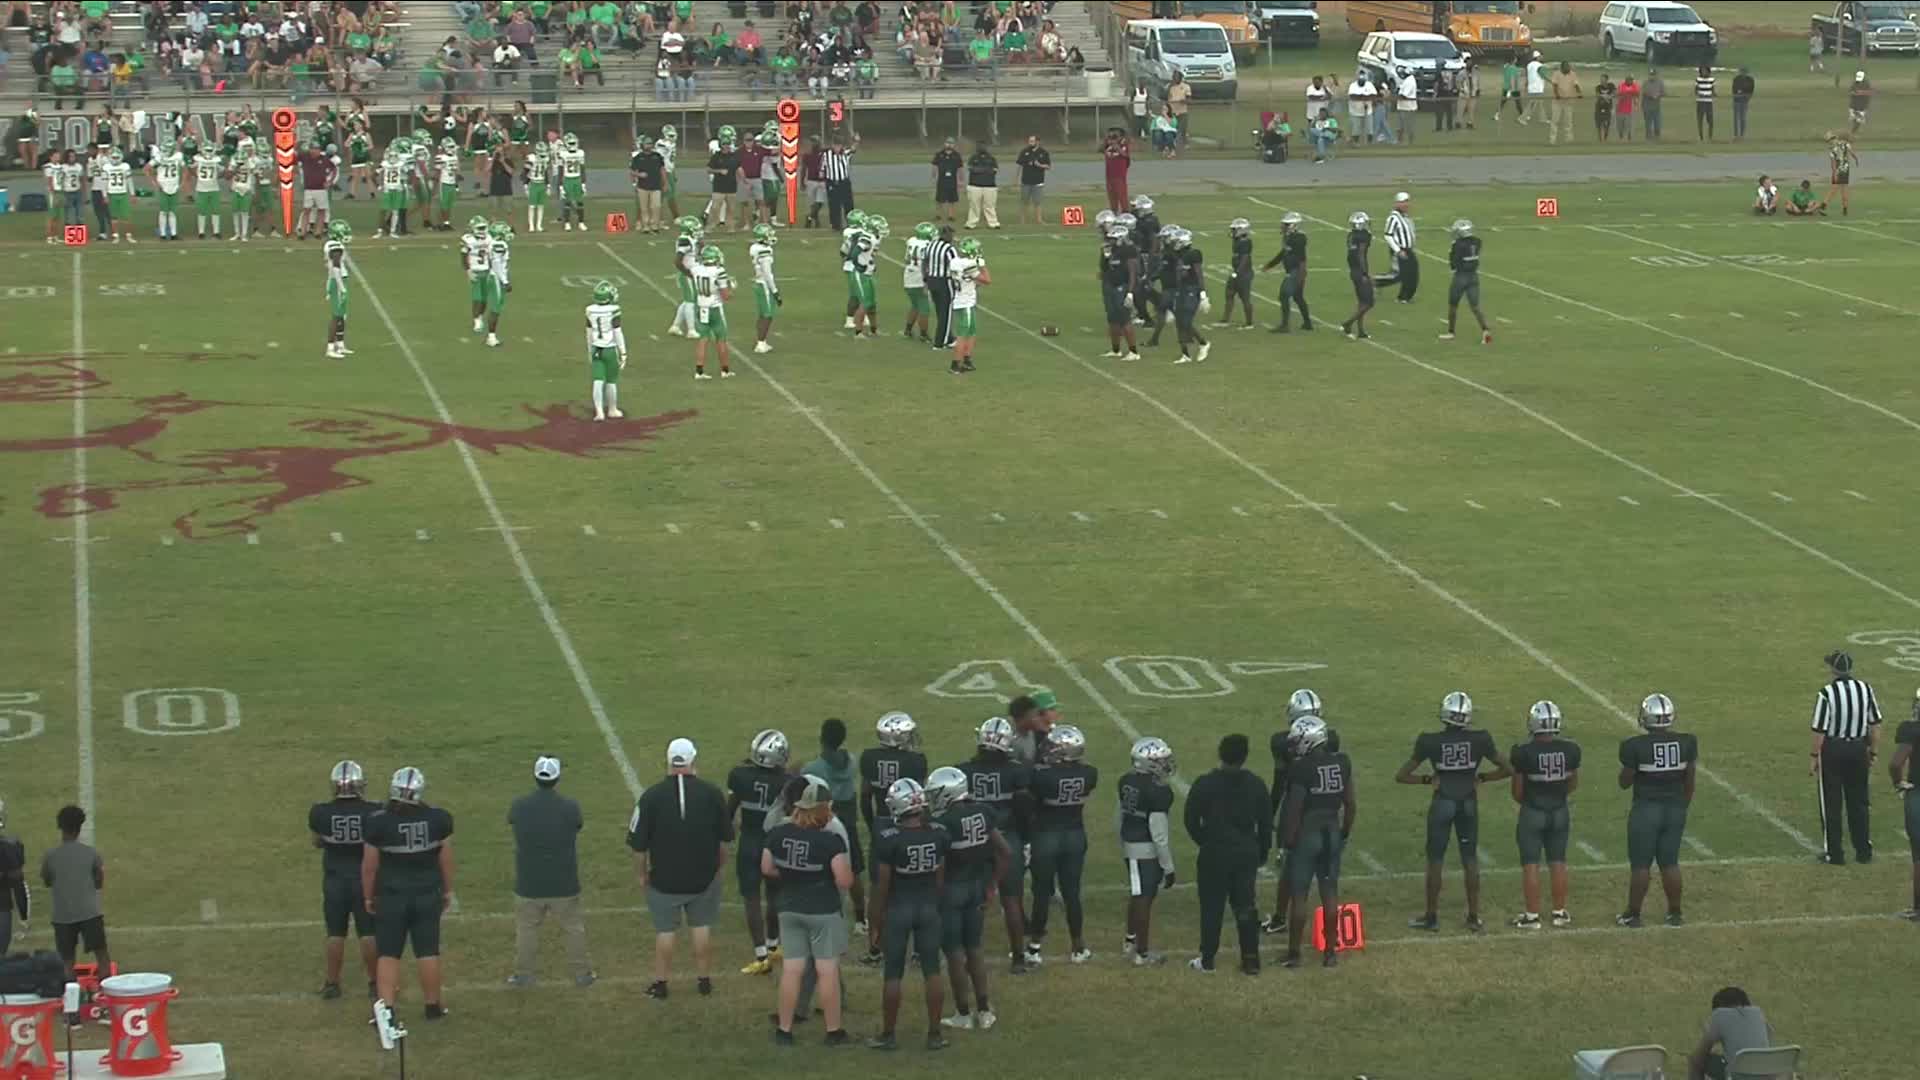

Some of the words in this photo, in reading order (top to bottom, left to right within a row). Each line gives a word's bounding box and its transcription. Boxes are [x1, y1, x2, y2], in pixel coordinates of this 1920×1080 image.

[829, 102, 843, 121] 3
[110, 172, 124, 187] 33
[163, 164, 178, 179] 72
[199, 165, 215, 180] 57
[385, 169, 399, 184] 12
[1067, 208, 1082, 224] 30
[1539, 200, 1556, 215] 20
[611, 216, 625, 229] 40
[66, 228, 84, 243] 50
[696, 275, 711, 298] 10
[594, 316, 605, 340] 1
[1440, 741, 1472, 769] 23
[1537, 751, 1566, 782] 44
[1652, 741, 1681, 768] 90
[1316, 764, 1345, 794] 15
[331, 814, 361, 843] 56
[397, 821, 428, 850] 74
[960, 813, 989, 845] 42
[782, 837, 810, 868] 72
[907, 842, 937, 872] 35
[10, 1017, 36, 1046] G
[122, 1007, 149, 1037] G
